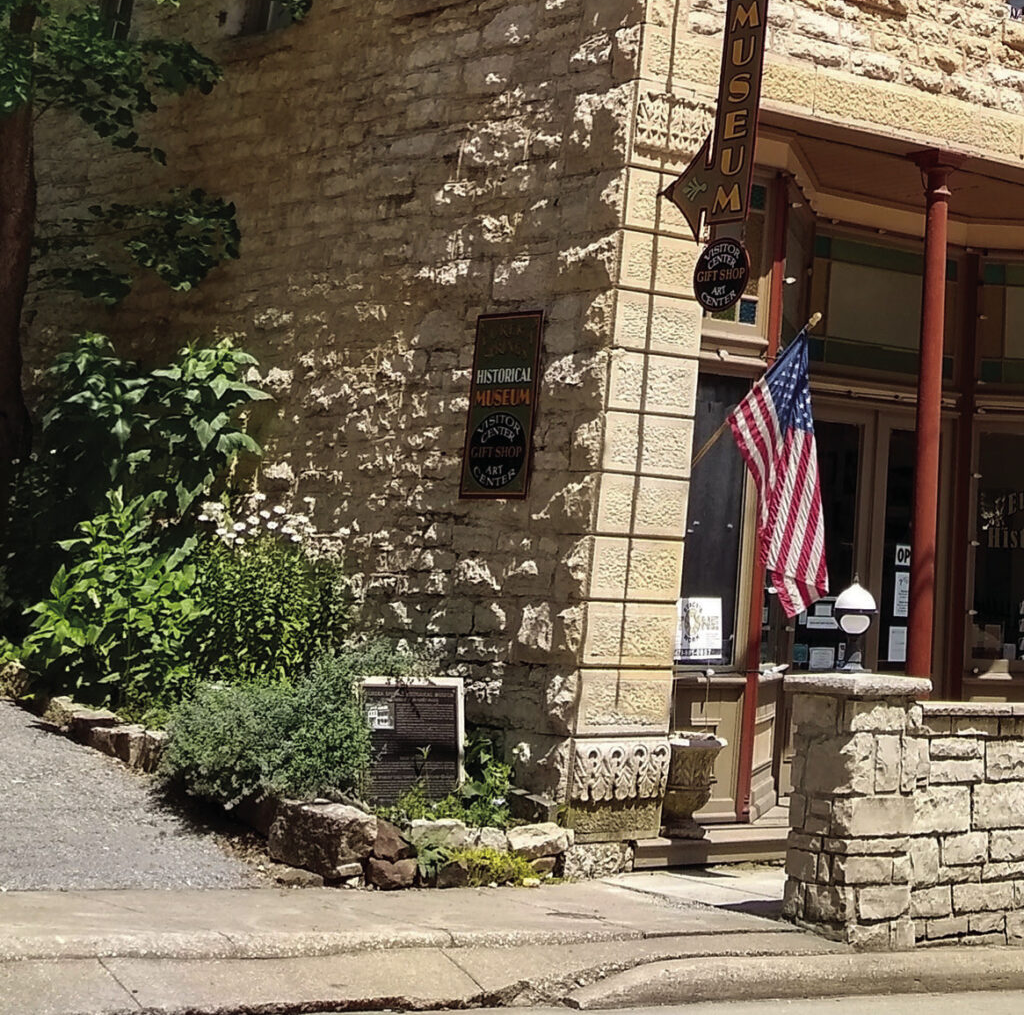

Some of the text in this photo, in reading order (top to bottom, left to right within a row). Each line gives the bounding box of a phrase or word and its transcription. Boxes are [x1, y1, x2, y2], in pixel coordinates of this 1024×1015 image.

[711, 0, 761, 214] MUSEUM
[704, 243, 741, 260] VISITOR
[707, 253, 737, 270] CENTER
[696, 267, 745, 282] GIFT SHOP
[700, 289, 737, 307] CENTER
[711, 285, 726, 296] ART
[476, 367, 532, 385] HISTORICAL
[475, 388, 531, 407] MUSEUM
[477, 414, 521, 435] VISITOR
[480, 426, 516, 444] CENTER
[471, 445, 522, 459] GIFT SHOP
[473, 466, 516, 487] CENTER
[486, 464, 503, 475] ART
